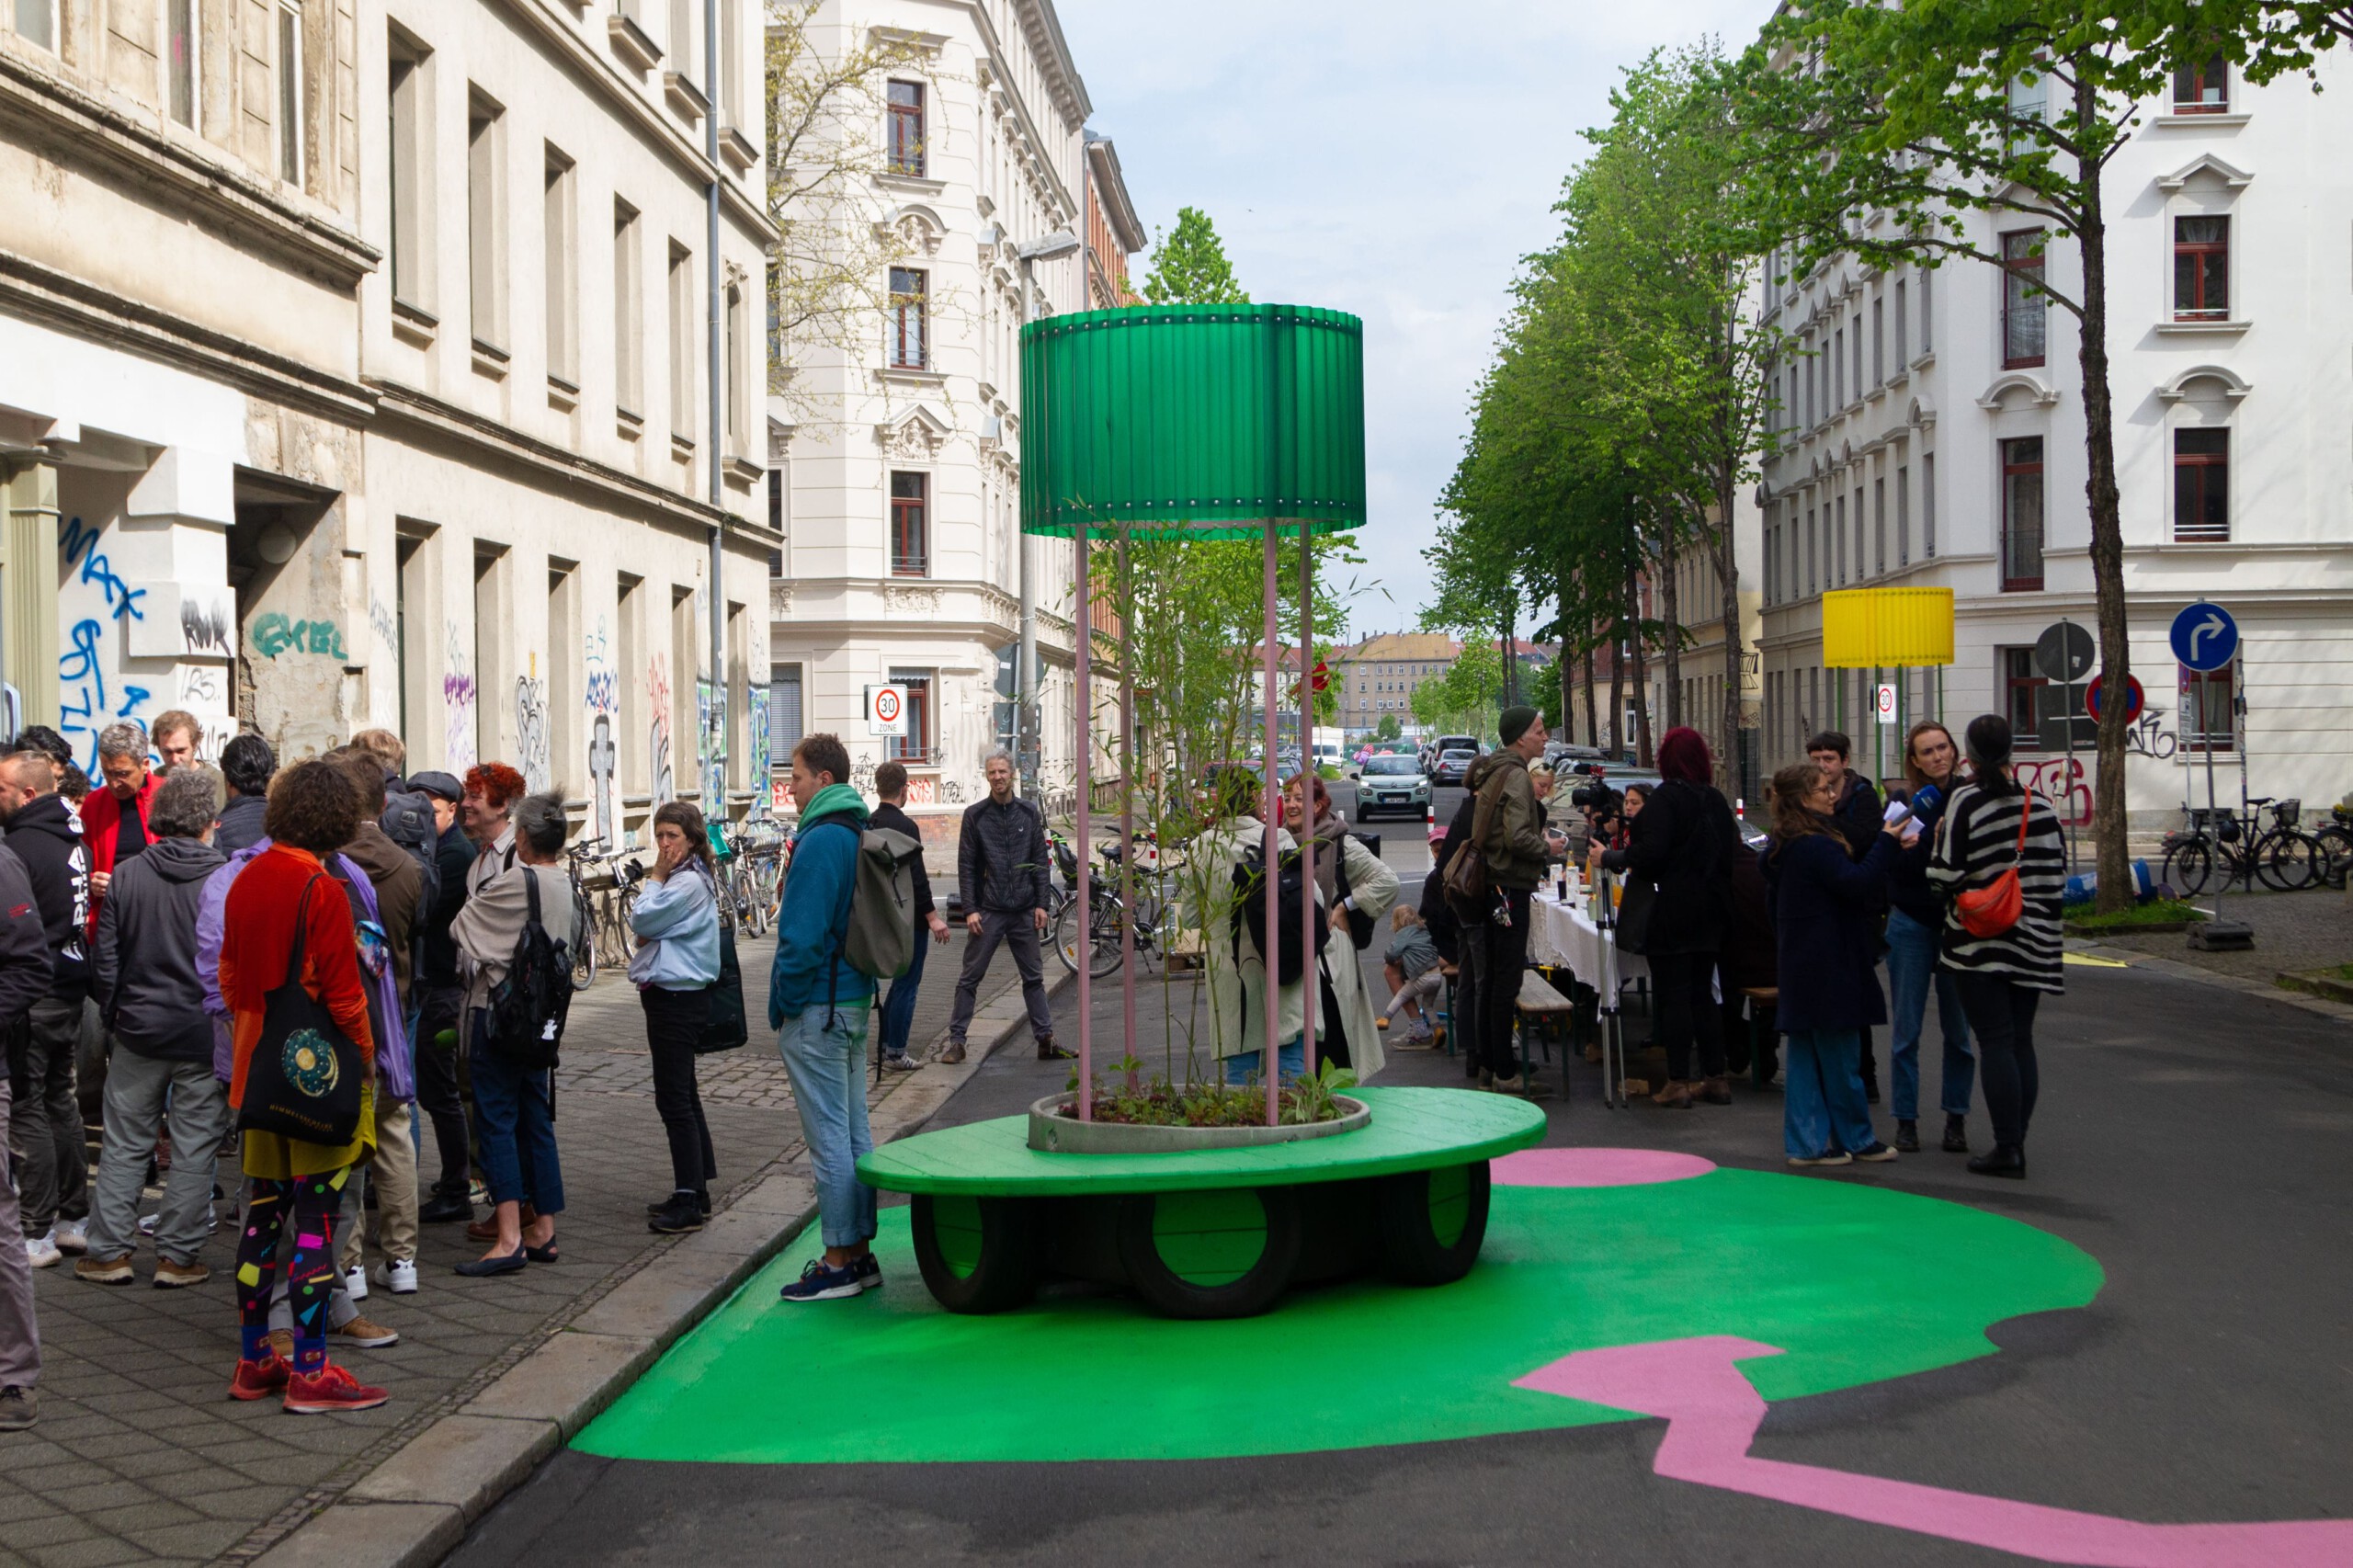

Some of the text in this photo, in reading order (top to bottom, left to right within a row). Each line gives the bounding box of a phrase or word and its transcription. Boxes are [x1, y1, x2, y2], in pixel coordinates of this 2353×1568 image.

[881, 698, 895, 713] 30
[1881, 694, 1890, 706] 30
[879, 723, 897, 733] ZONE
